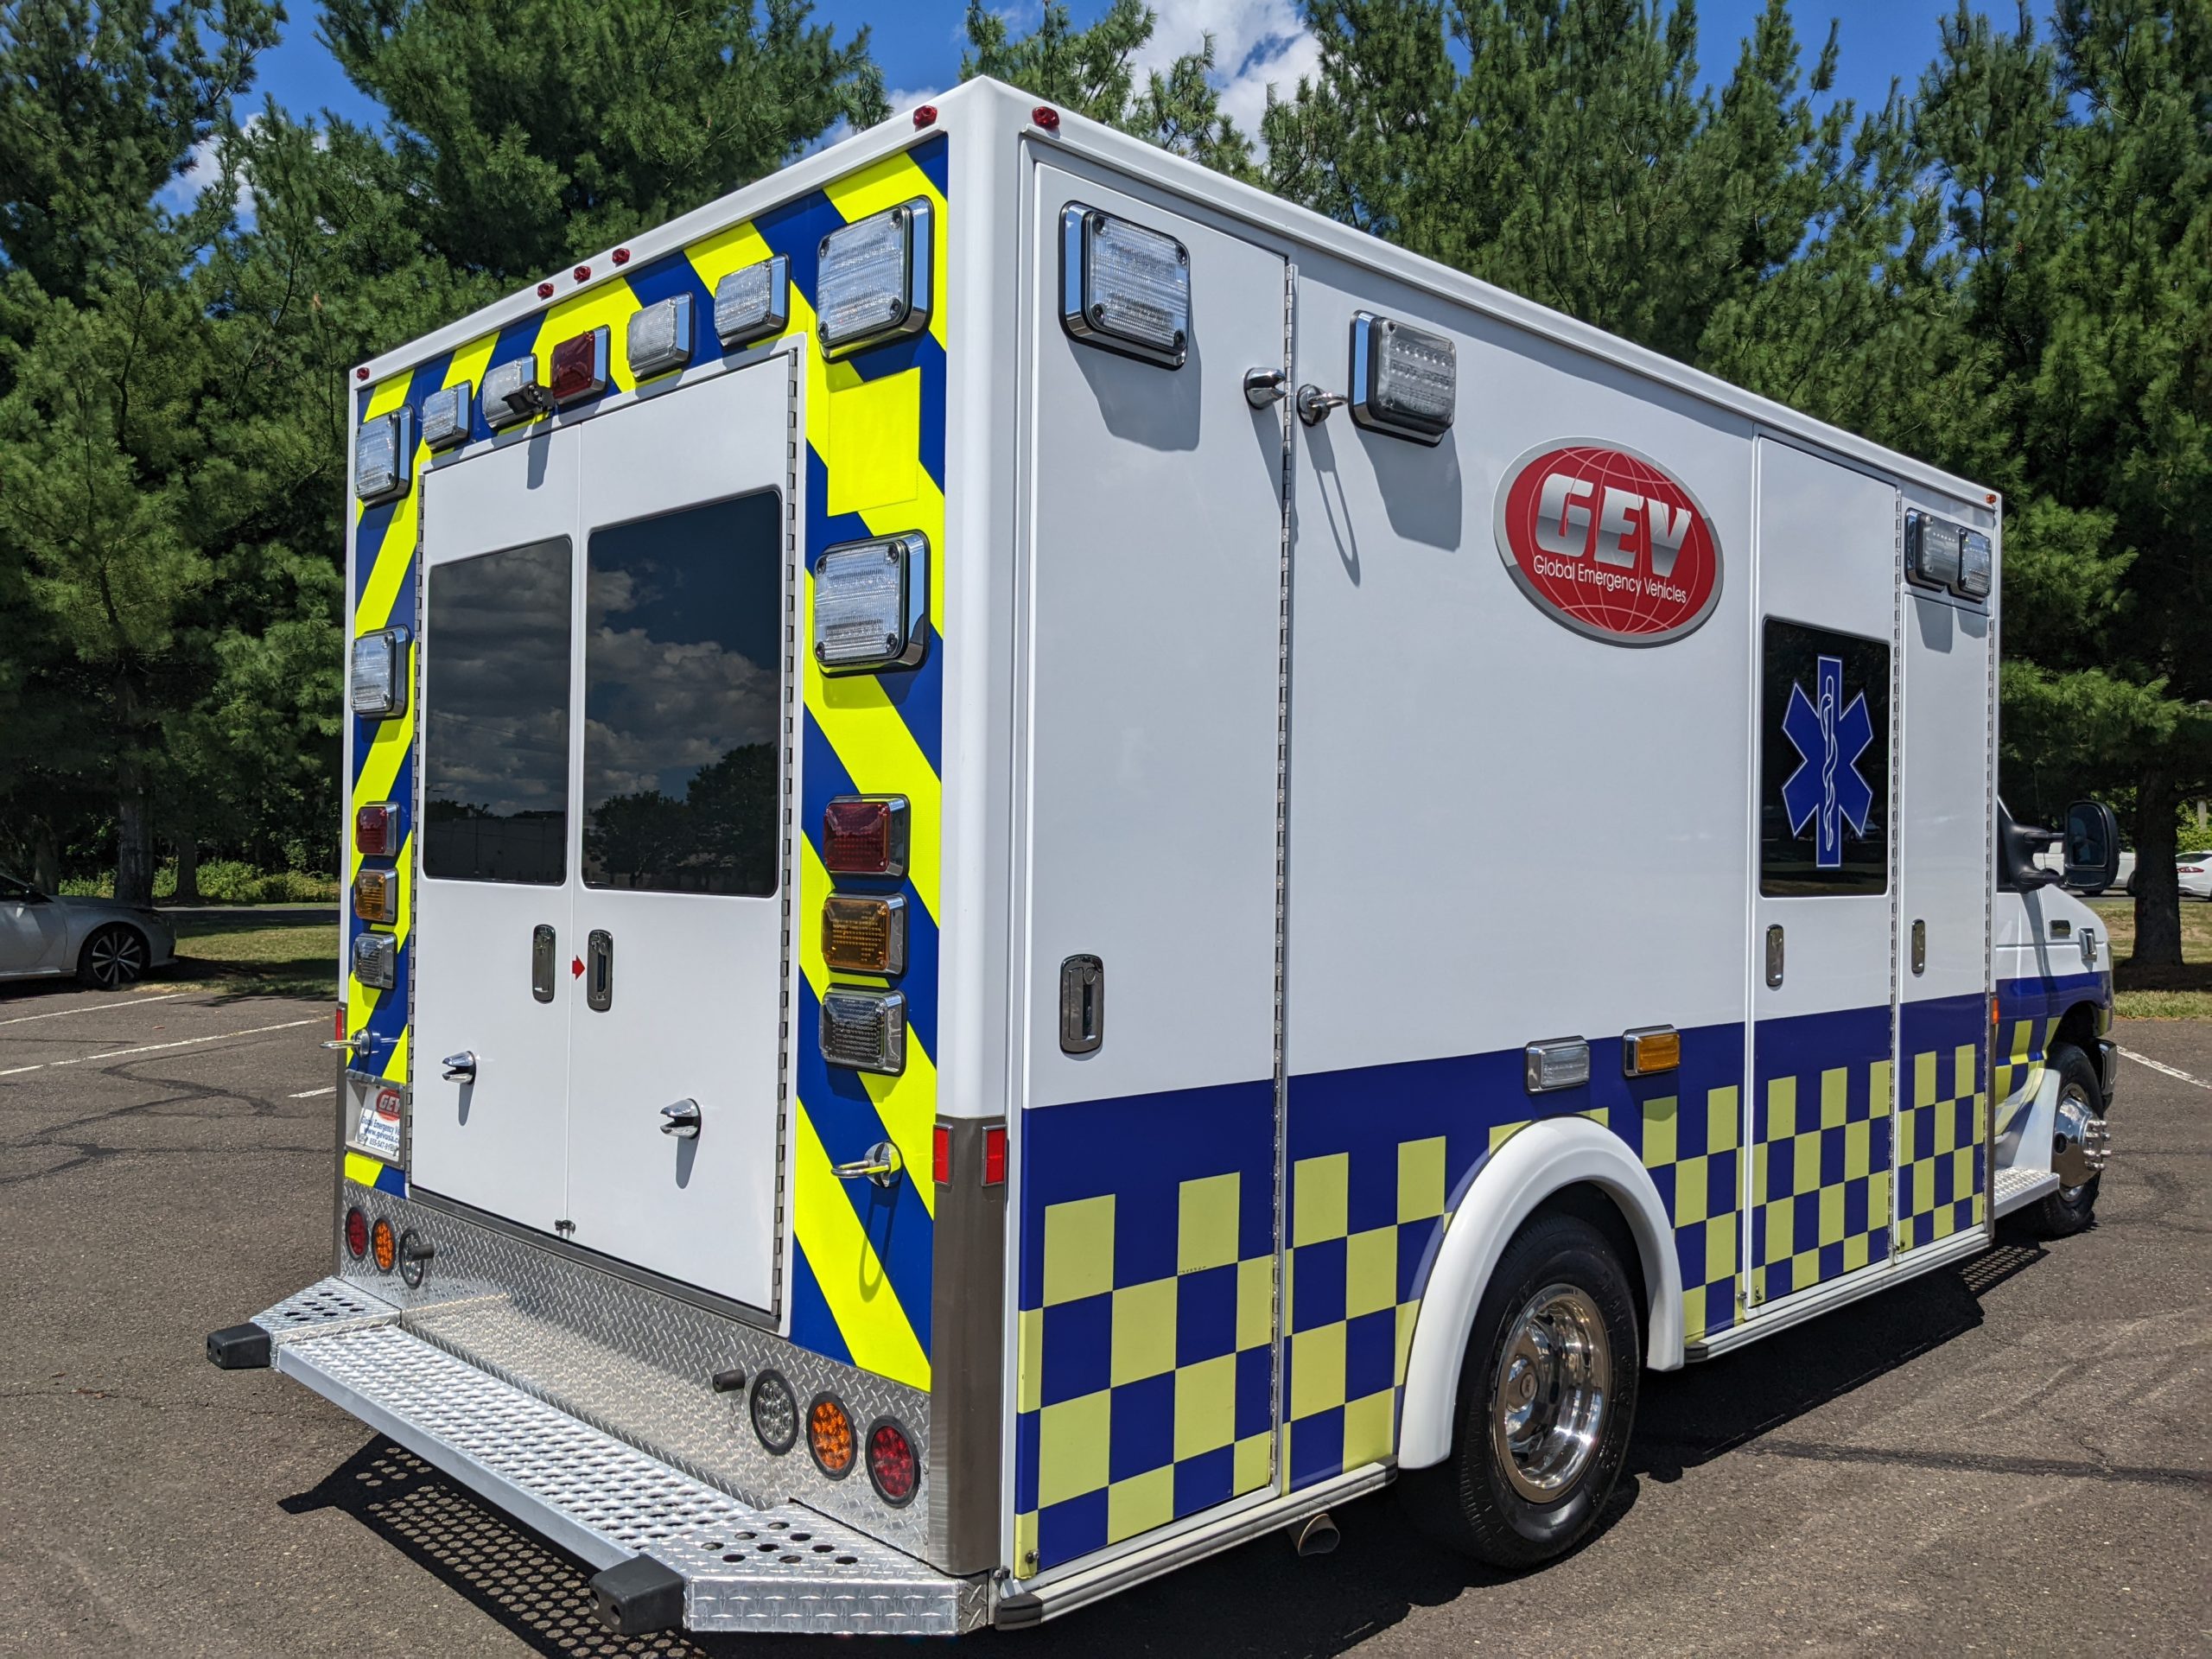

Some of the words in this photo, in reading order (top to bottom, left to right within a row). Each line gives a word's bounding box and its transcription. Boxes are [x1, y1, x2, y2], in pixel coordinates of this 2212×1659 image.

[1535, 473, 1693, 578] GEV
[1533, 555, 1575, 580] Global
[1578, 563, 1642, 597] Emergency
[1643, 576, 1687, 603] Vehicles
[364, 1127, 399, 1143] www.gevusa.c
[373, 1119, 395, 1135] Emergency
